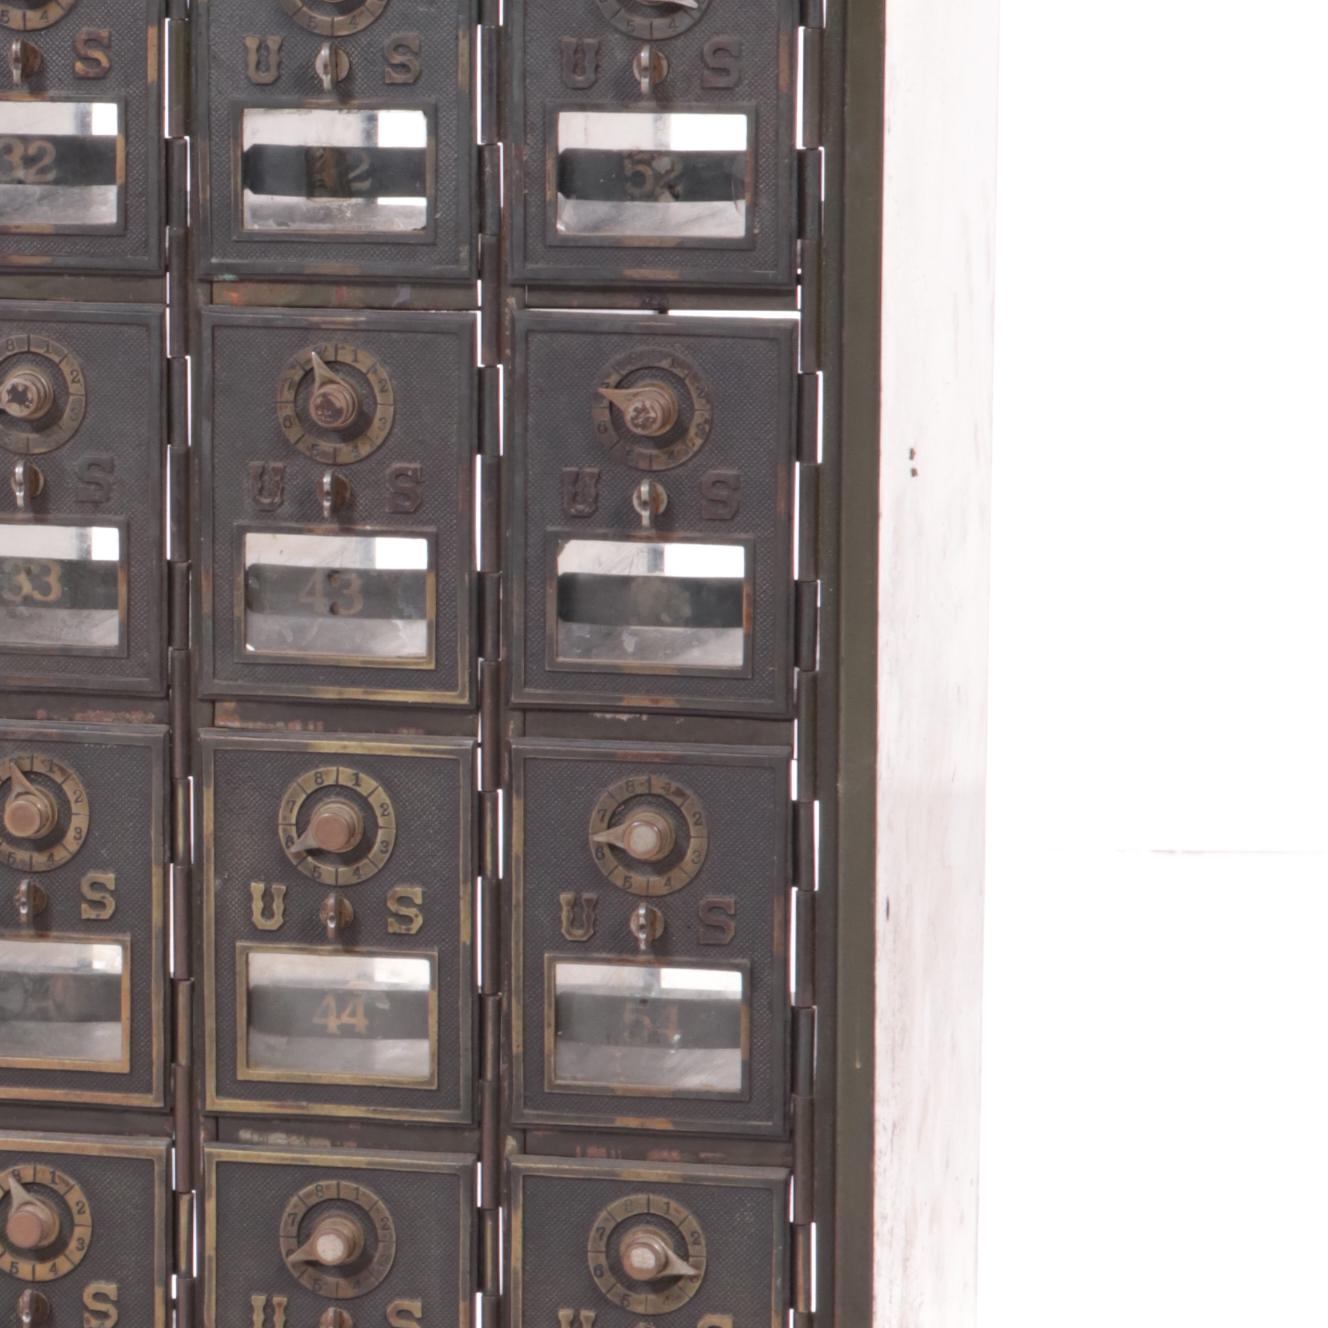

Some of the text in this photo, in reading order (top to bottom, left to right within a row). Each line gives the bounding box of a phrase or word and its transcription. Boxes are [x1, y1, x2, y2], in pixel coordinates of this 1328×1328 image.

[73, 27, 111, 79] S
[244, 33, 422, 84] U S
[561, 36, 741, 89] U S
[75, 453, 115, 503] S
[248, 460, 425, 514] U S
[561, 466, 742, 521] U S
[1, 560, 61, 602] 33
[298, 569, 364, 614] 43
[80, 872, 117, 920] S
[250, 881, 423, 934] U S
[559, 891, 736, 944] U S
[313, 993, 368, 1034] 44
